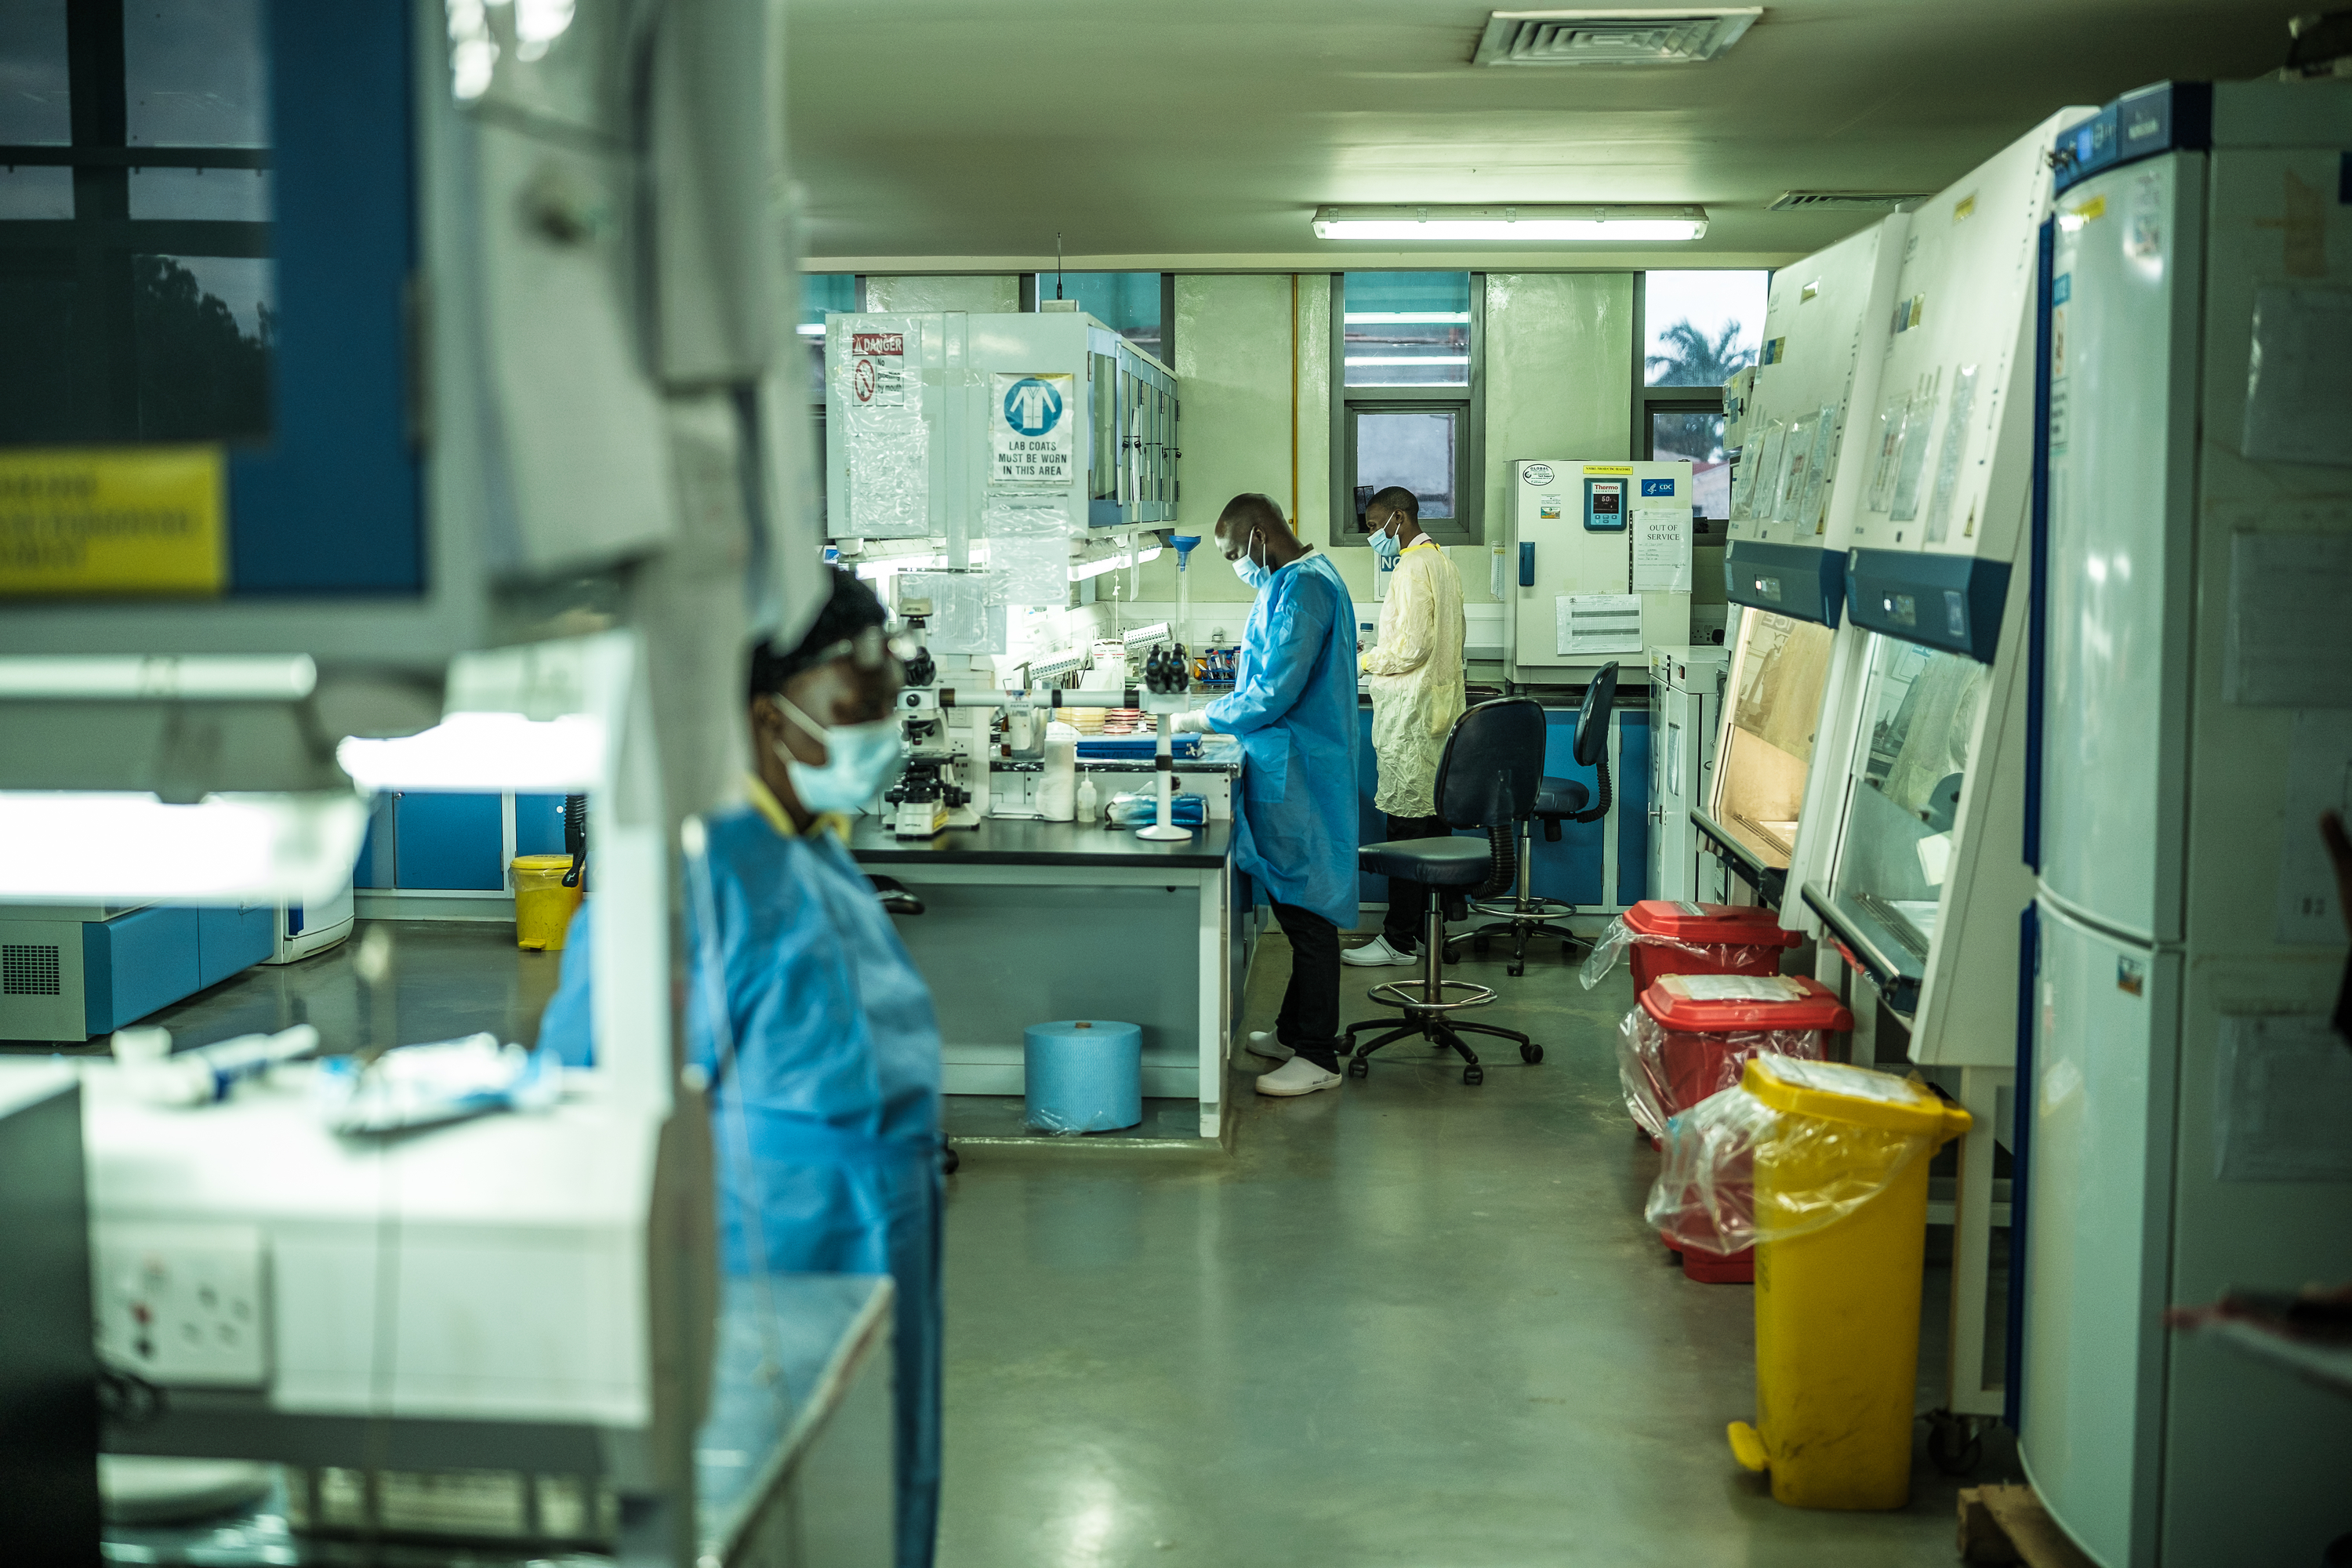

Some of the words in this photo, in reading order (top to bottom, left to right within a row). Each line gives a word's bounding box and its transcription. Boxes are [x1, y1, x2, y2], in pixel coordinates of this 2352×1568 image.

[864, 338, 902, 351] DANGER
[878, 383, 884, 394] by
[885, 383, 902, 392] mouth
[1009, 441, 1025, 451] LAB
[1029, 441, 1057, 451] COATS
[998, 453, 1023, 463] MUST
[1026, 453, 1037, 463] BE
[1041, 454, 1067, 463] WORN
[1003, 466, 1012, 474] IN
[1015, 466, 1035, 475] THIS
[1039, 466, 1062, 476] AREA
